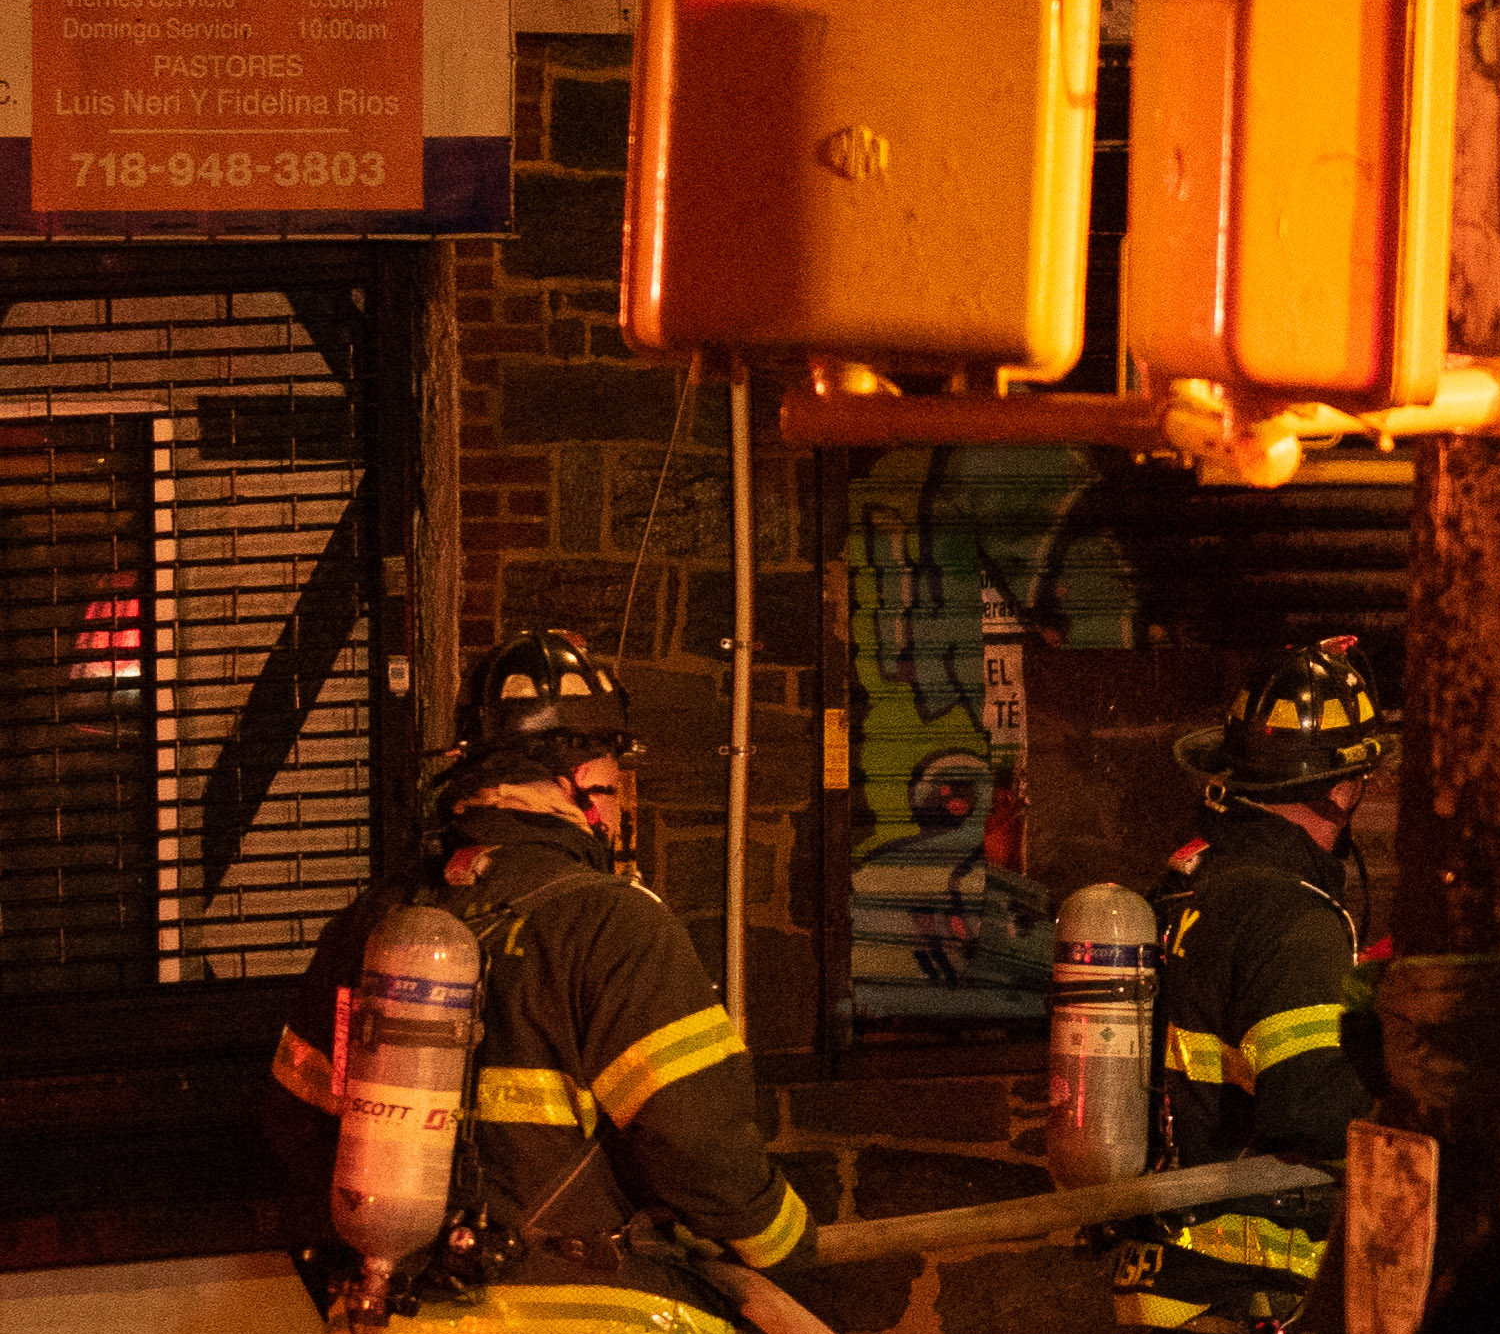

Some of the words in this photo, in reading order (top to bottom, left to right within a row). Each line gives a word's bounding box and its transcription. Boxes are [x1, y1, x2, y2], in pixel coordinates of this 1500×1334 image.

[62, 17, 161, 45] Domingo
[166, 17, 254, 41] Servicio
[298, 17, 388, 41] 10:00am
[154, 54, 304, 79] PASTORES
[55, 89, 116, 116] Luis
[123, 89, 182, 116] Neri
[187, 88, 207, 115] Y
[217, 88, 330, 116] Fidelina
[337, 89, 400, 116] Rios
[70, 152, 387, 188] 718-948-3803
[350, 1096, 413, 1121] SCOTT
